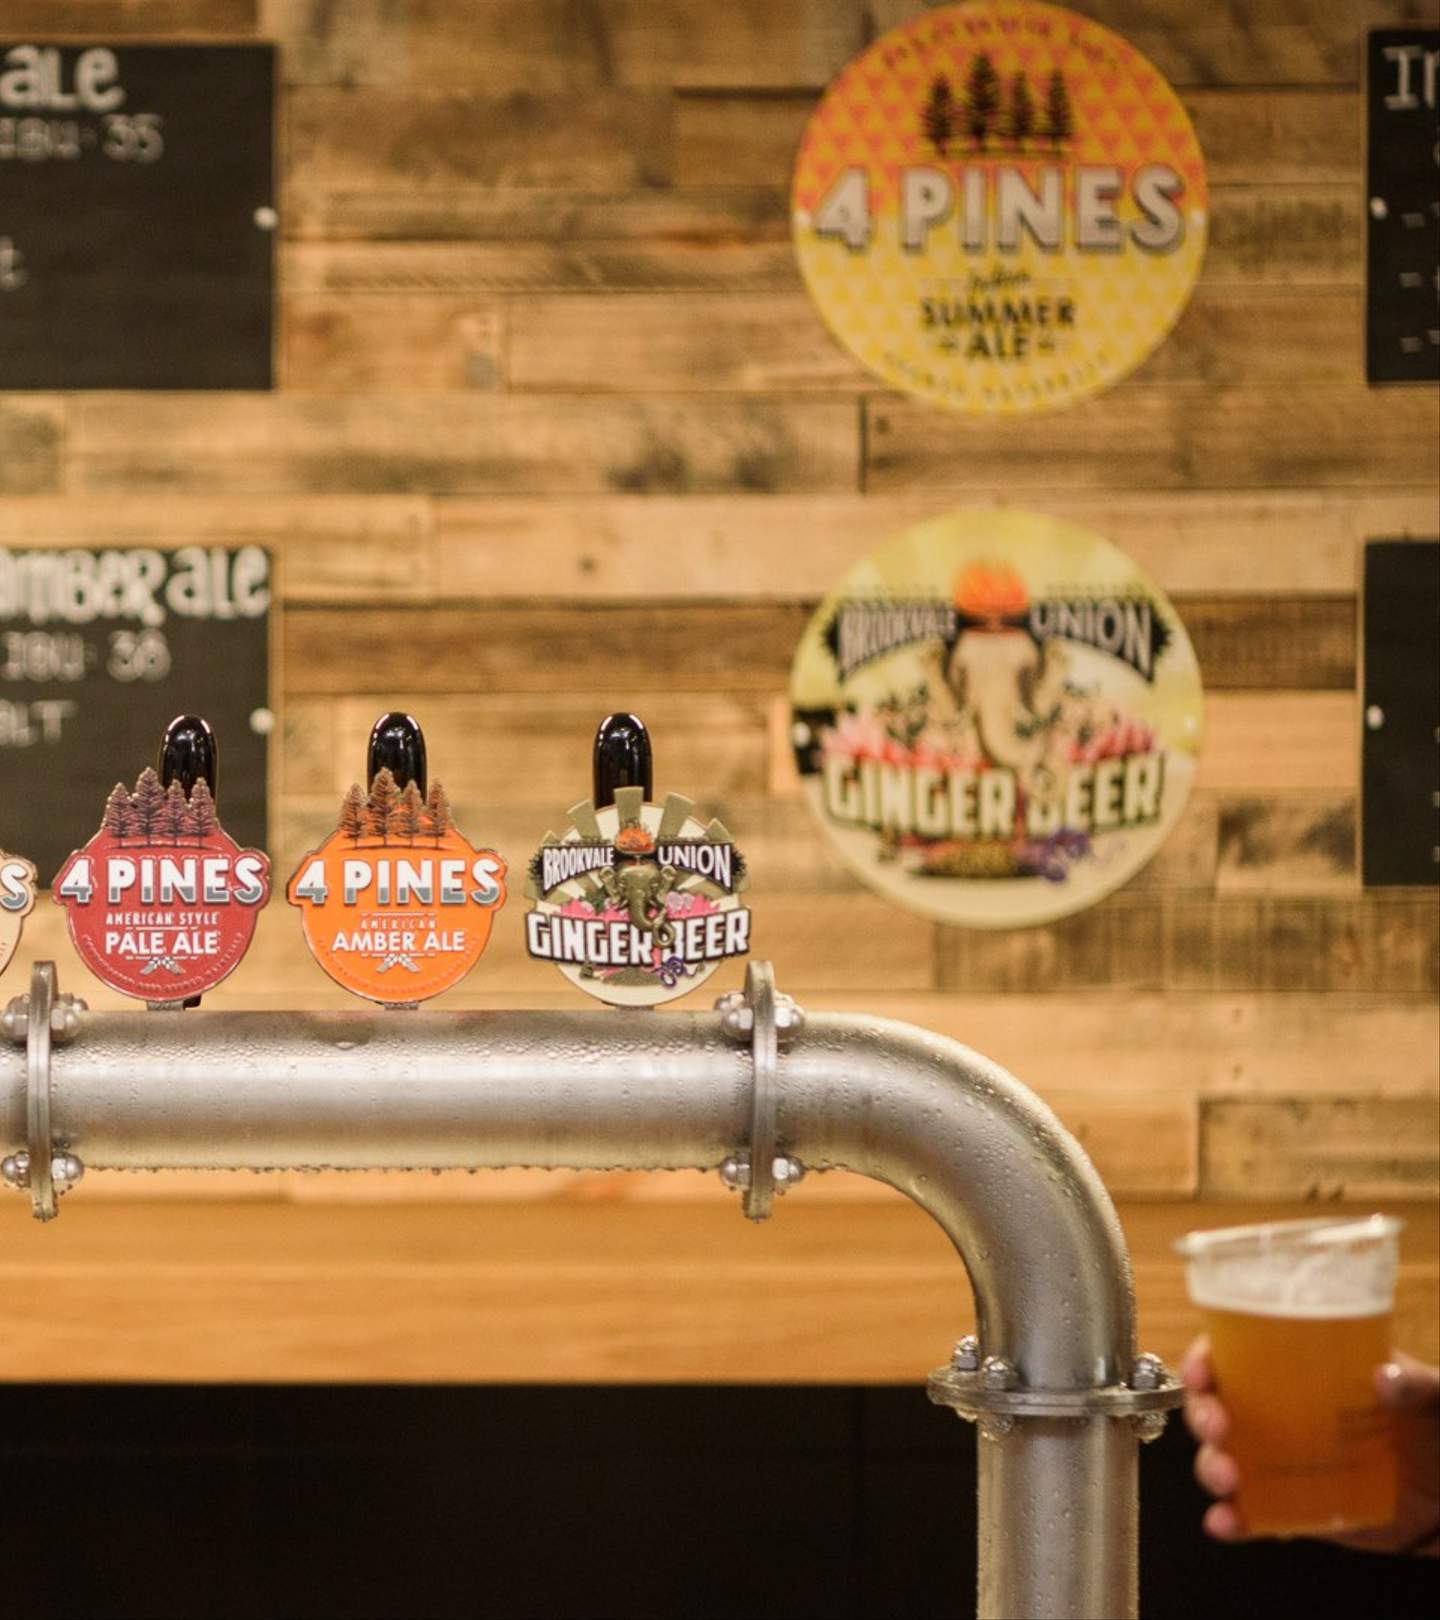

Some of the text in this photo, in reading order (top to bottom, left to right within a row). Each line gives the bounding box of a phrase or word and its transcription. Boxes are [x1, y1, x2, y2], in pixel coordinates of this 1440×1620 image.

[813, 164, 1186, 254] 4 PINES
[921, 297, 1076, 329] SUMMER
[964, 329, 1031, 360] ALE
[1030, 600, 1152, 674] UNION
[826, 757, 1016, 838] GINGER
[60, 857, 264, 905] 4 PINES
[296, 858, 501, 905] 4 PINES
[543, 845, 731, 891] BROOKVALE UNION
[106, 912, 219, 925] AMERICAN STYLE
[332, 931, 465, 952] AMBER ALE
[360, 919, 437, 929] AMERICAN
[527, 912, 654, 964] GINGER
[106, 932, 219, 954] PALE ALE
